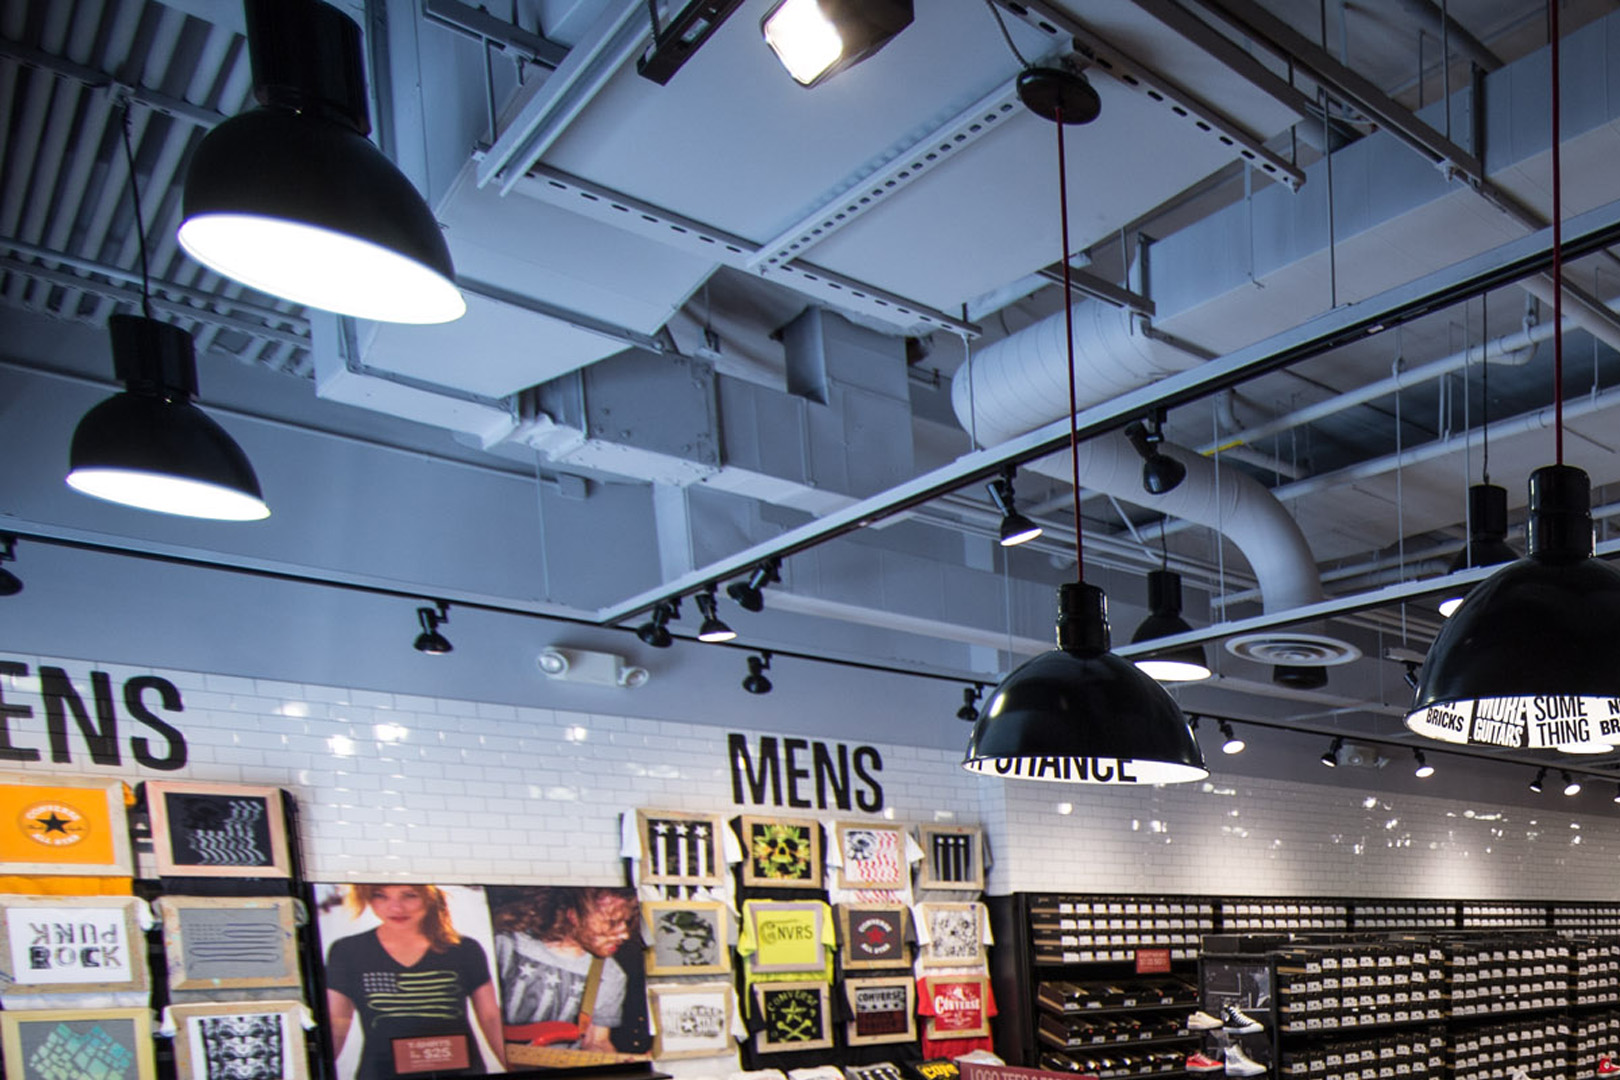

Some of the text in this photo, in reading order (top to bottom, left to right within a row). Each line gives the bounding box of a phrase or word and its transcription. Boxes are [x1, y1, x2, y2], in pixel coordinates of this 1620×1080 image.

[1426, 707, 1464, 733] BRICKS
[1534, 696, 1588, 722] SOME
[1473, 718, 1524, 748] GUITARS
[1536, 719, 1591, 747] THING
[728, 733, 884, 813] MENS
[28, 945, 122, 970] ROCK
[767, 989, 818, 1011] CONVERSE
[934, 996, 981, 1015] CONVERSE
